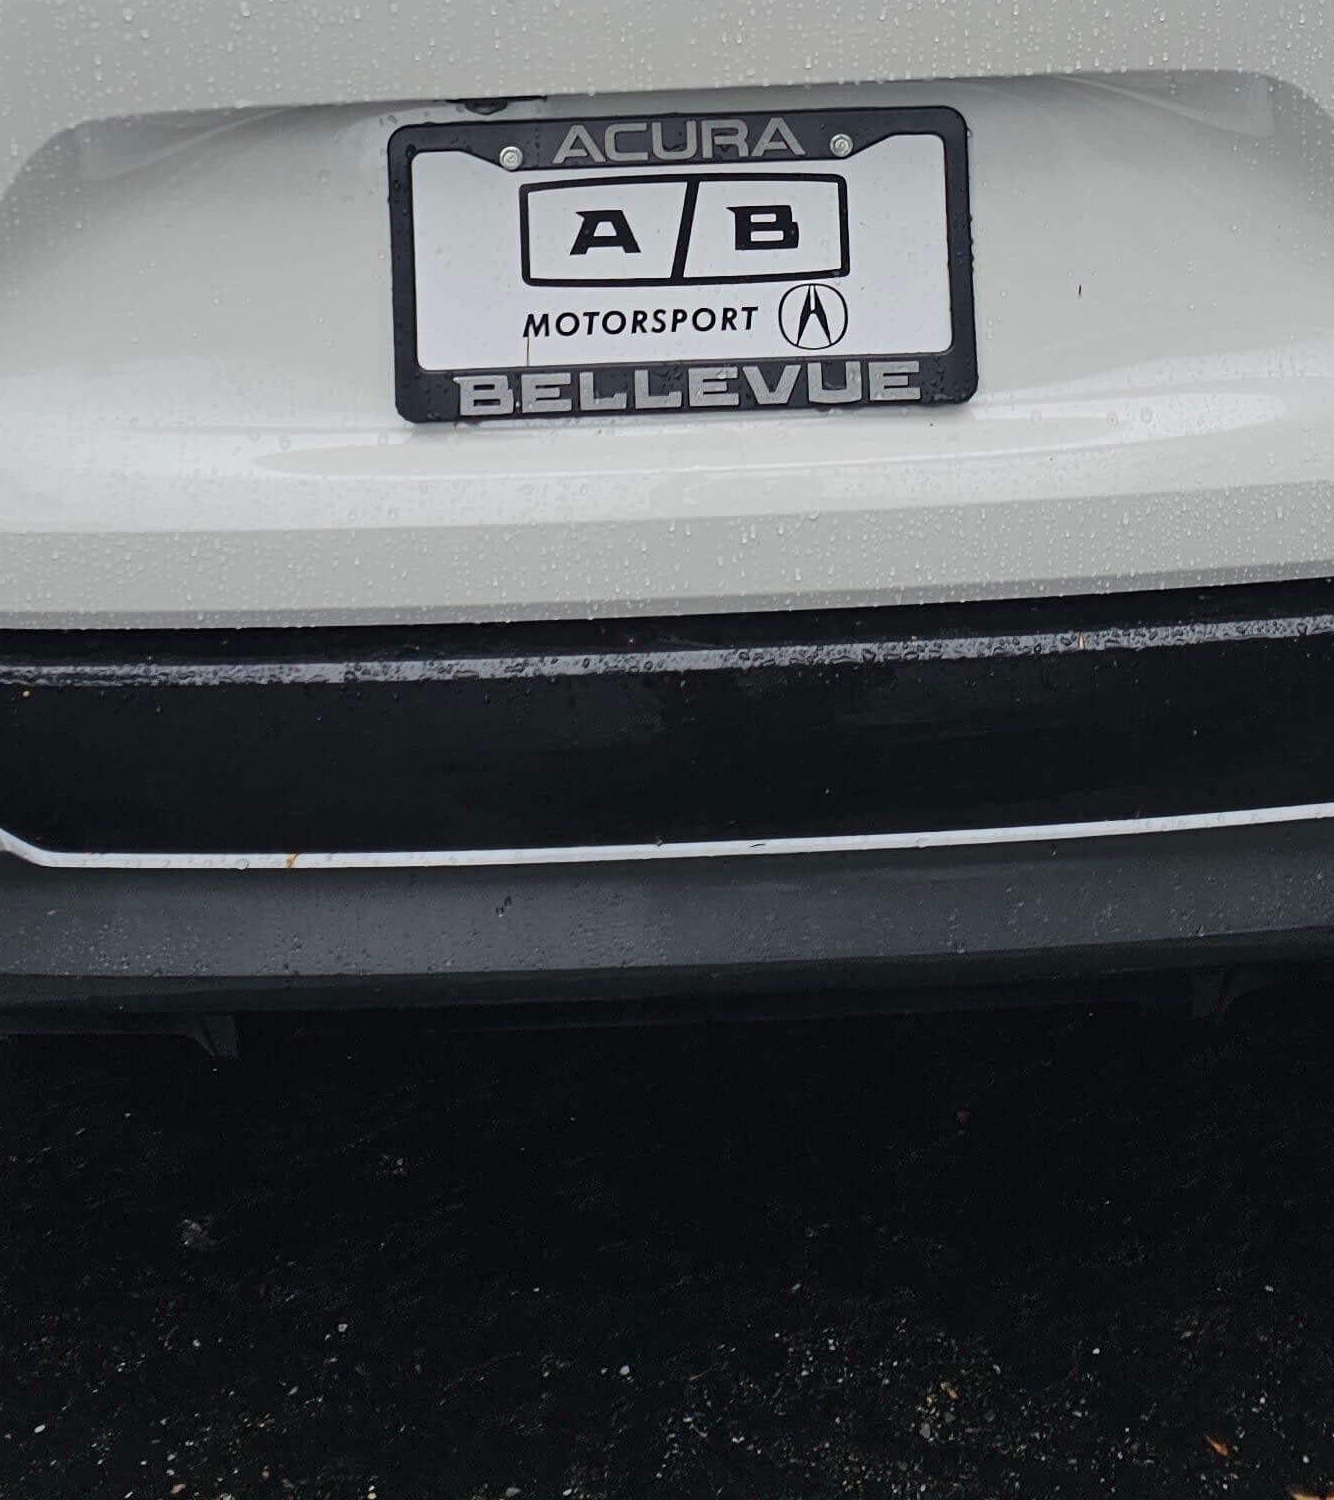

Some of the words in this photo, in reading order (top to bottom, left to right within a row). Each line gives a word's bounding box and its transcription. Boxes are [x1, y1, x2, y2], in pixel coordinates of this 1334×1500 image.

[553, 118, 806, 164] ACURA
[570, 209, 641, 255] A
[727, 204, 799, 250] B
[523, 306, 759, 338] MOTORSPORT
[453, 360, 923, 416] BELLEVUE
